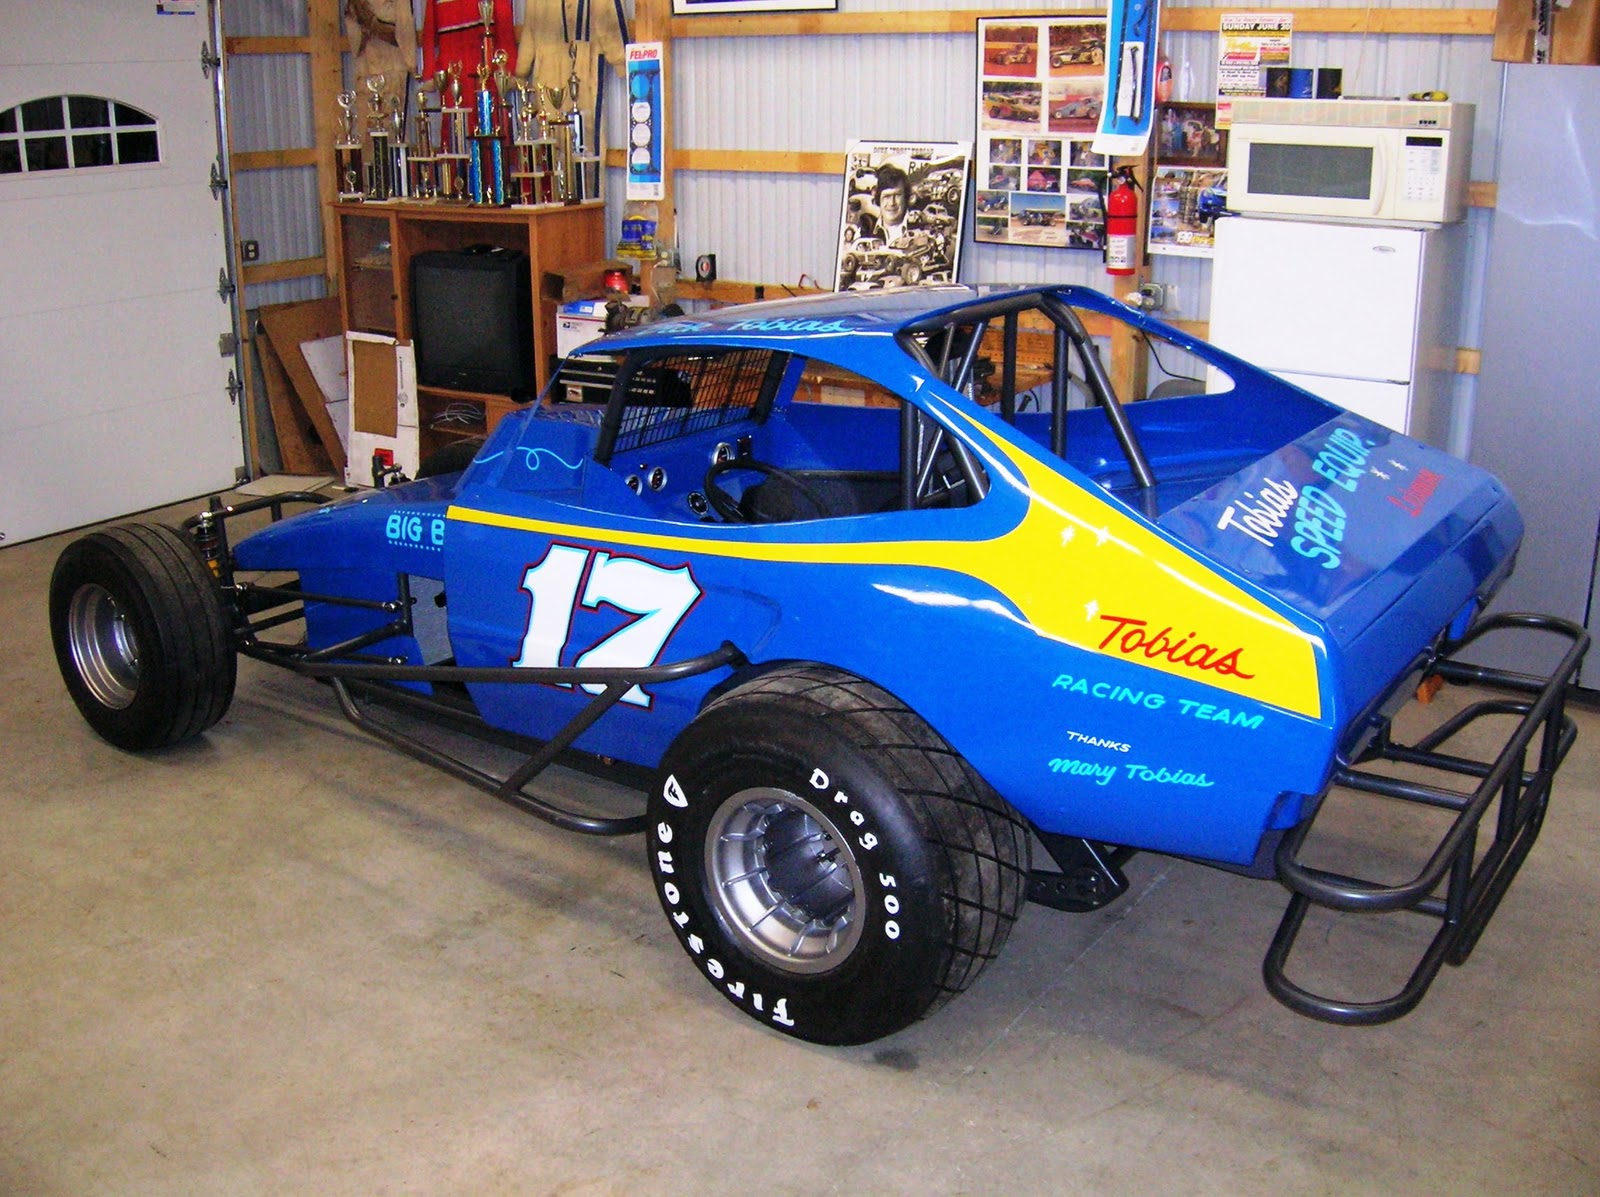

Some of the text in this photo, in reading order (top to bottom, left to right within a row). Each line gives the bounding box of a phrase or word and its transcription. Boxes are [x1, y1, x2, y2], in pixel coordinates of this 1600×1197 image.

[1222, 23, 1255, 31] SUNDAY
[1257, 23, 1279, 31] JUNE
[727, 317, 853, 332] Tobias
[386, 514, 445, 545] BIG B
[1216, 477, 1299, 548] Tobias
[1290, 485, 1347, 569] SPEED
[511, 541, 703, 709] 17
[1098, 614, 1256, 680] Tobias
[1052, 674, 1265, 730] RACING TEAM
[1066, 730, 1132, 753] THANKS
[1125, 763, 1215, 788] Tobias
[808, 767, 900, 940] Drag 500
[657, 821, 795, 1027] Firestone
